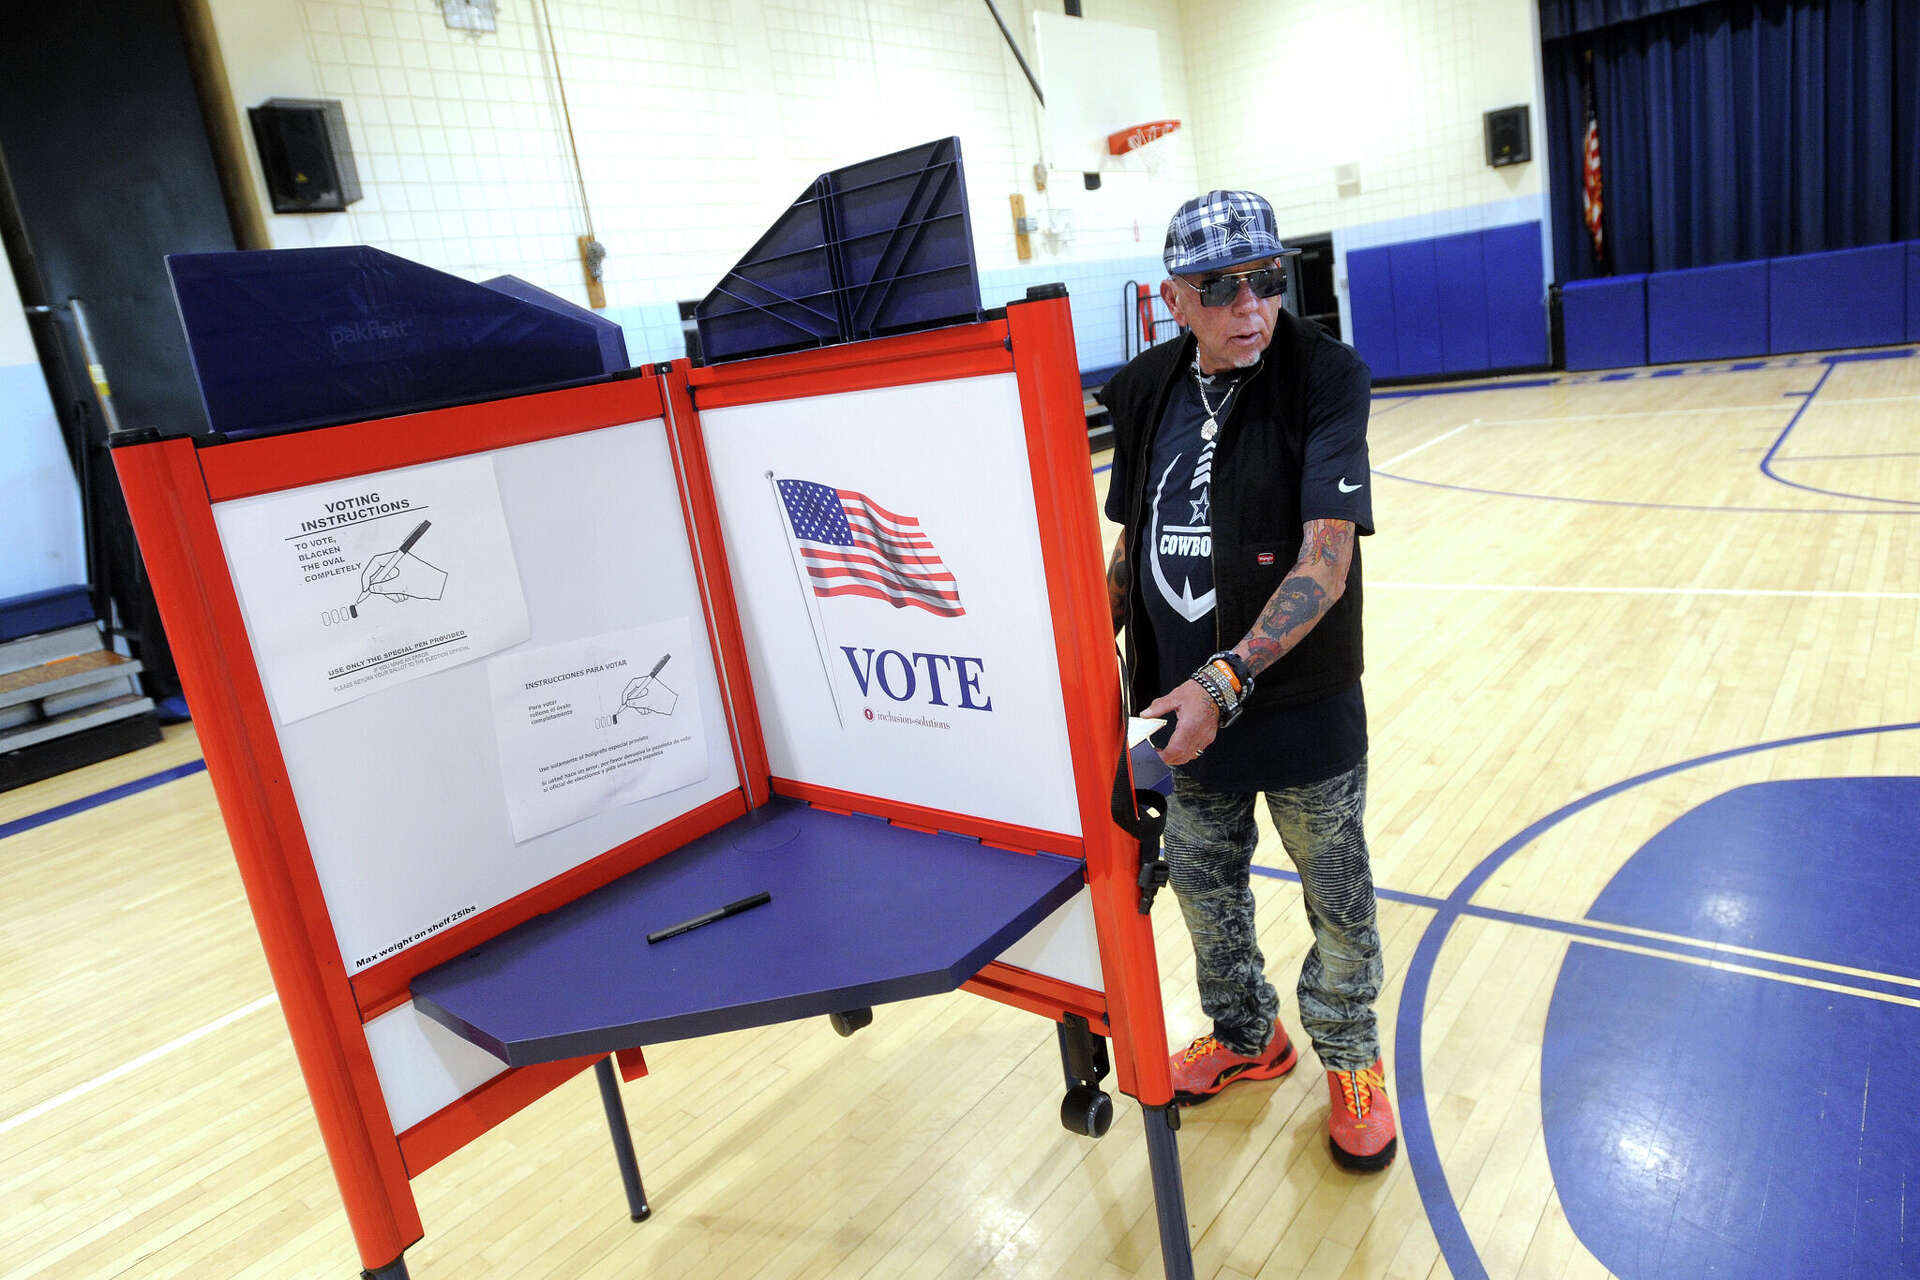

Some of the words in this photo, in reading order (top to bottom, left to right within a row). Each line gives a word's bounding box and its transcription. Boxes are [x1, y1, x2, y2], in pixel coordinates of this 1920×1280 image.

[301, 499, 410, 532] INSTRUCTIONS
[325, 493, 380, 513] VOTING
[295, 543, 308, 551] TO
[310, 536, 337, 548] VOTE,
[299, 546, 341, 561] BLACKEN
[301, 562, 320, 572] THE
[322, 556, 345, 567] OVAL
[304, 562, 362, 583] COMPLETELY
[328, 666, 345, 676] USE
[346, 660, 365, 670] ONLY
[367, 655, 382, 664] THE
[383, 645, 413, 660] SPECIAL
[414, 640, 429, 649] PEN
[429, 629, 465, 645] PROVIDED
[525, 669, 584, 690] INSTRUCCIONES
[585, 664, 604, 675] PARA
[605, 659, 627, 670] VOTAR
[839, 646, 993, 712] VOTE
[355, 954, 378, 968] Max
[379, 936, 413, 957] weight
[414, 930, 427, 940] on
[427, 915, 451, 933] shelf
[450, 904, 477, 921] 25lbs
